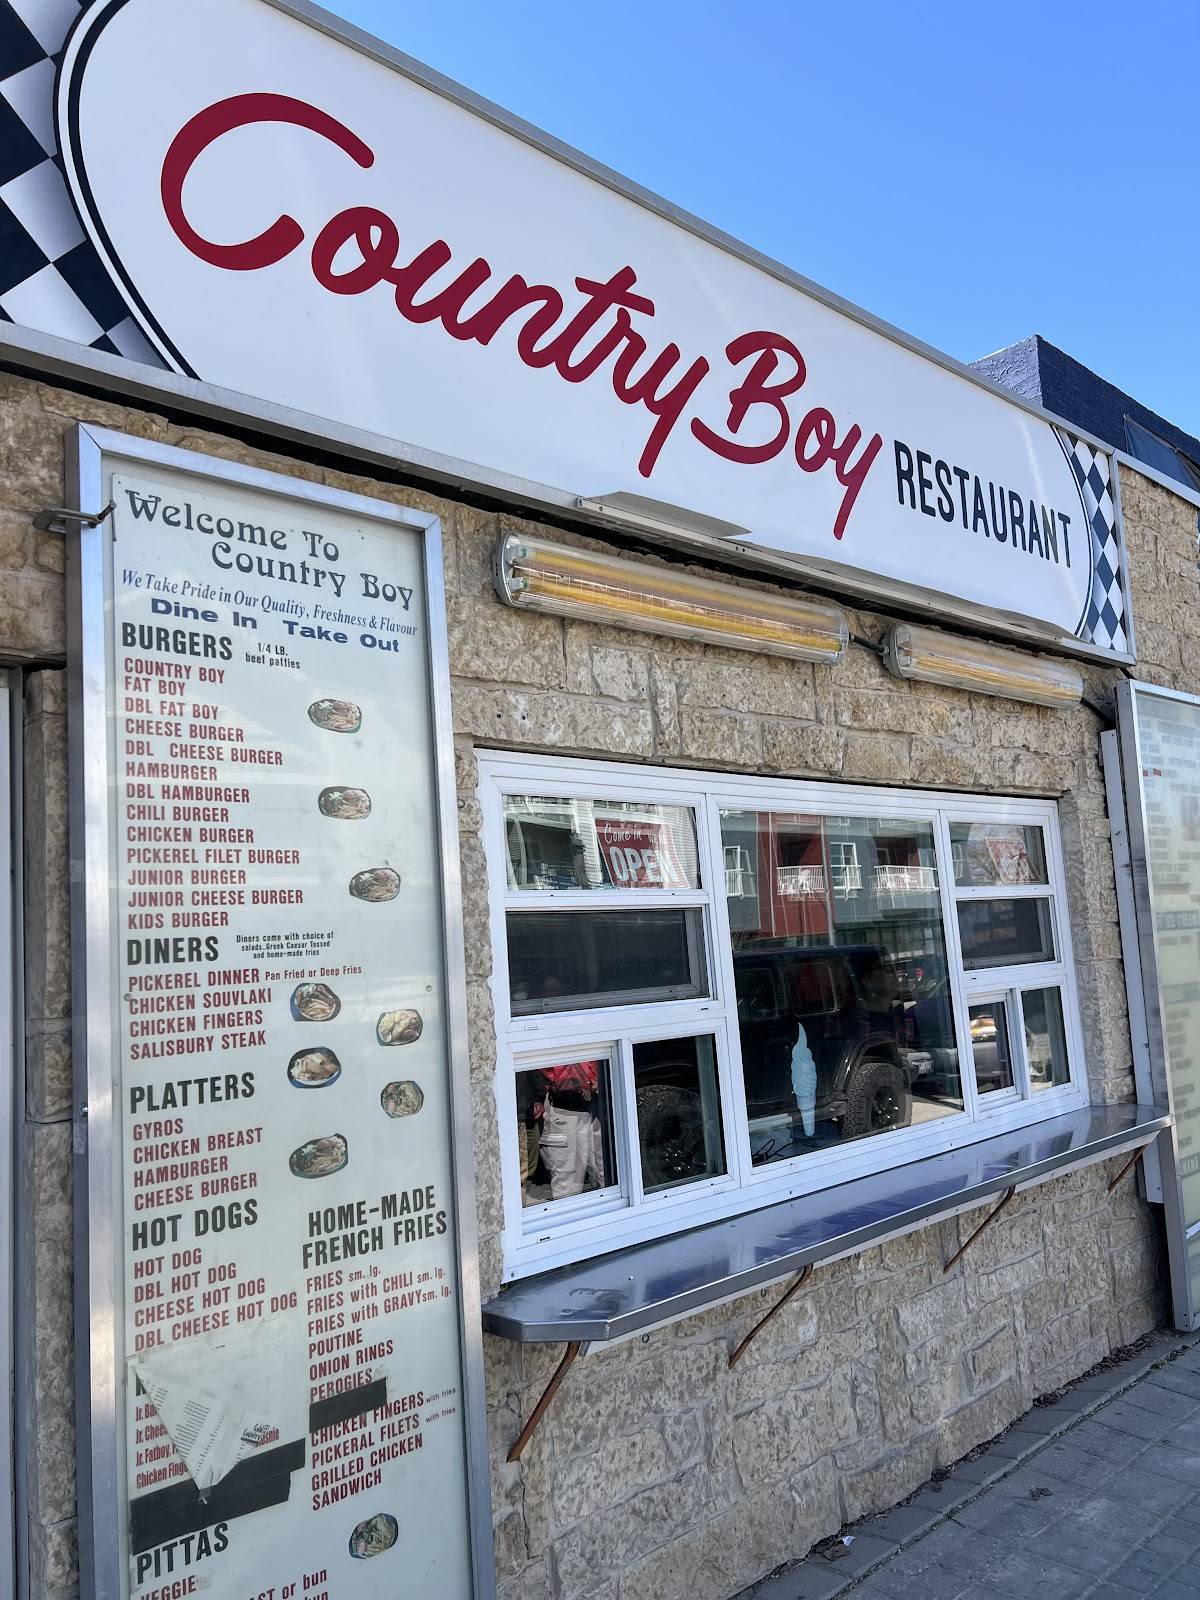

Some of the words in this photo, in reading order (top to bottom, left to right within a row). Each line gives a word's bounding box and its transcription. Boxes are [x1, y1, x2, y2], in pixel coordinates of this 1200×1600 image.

[160, 92, 709, 478] Country
[690, 330, 883, 540] Boy
[893, 439, 1071, 568] RESTAURANT
[125, 489, 288, 550] Welcome
[302, 530, 340, 562] To
[212, 541, 346, 598] Country
[360, 572, 414, 611] Boy
[122, 569, 143, 588] We
[145, 573, 179, 594] Take
[181, 580, 216, 601] Pride
[218, 588, 231, 603] in
[234, 590, 259, 608] Our
[261, 595, 310, 620] Quality,
[313, 604, 367, 629] Freshness
[368, 615, 378, 629] &
[380, 617, 418, 636] Flavour
[151, 597, 219, 623] Dine
[233, 611, 257, 630] In
[122, 622, 233, 661] BURGERS
[257, 642, 271, 655] 1/4
[275, 645, 288, 657] LB.
[282, 619, 349, 644] Take
[359, 633, 400, 653] Out
[124, 657, 192, 680] COUNTRY
[199, 667, 225, 684] BOY
[269, 655, 301, 669] patties
[124, 676, 152, 693] FAT
[158, 680, 186, 697] BOY
[125, 697, 153, 714] DBL
[159, 700, 185, 717] FAT
[192, 703, 219, 720] BOY
[125, 718, 183, 739] CHEESE
[189, 723, 245, 743] BURGER
[125, 739, 154, 757] DBL
[169, 742, 224, 762] CHEESE
[230, 747, 283, 766] BURGER
[126, 761, 218, 782] HAMBURGER
[126, 782, 155, 800] DBL
[161, 785, 250, 803] HAMBURGER
[126, 804, 166, 821] CHILI
[172, 806, 229, 823] BURGER
[126, 826, 193, 843] CHICKEN
[199, 828, 255, 844] BURGER
[604, 822, 632, 844] Come
[127, 848, 199, 864] PICKEREL
[204, 848, 242, 864] FILET
[248, 849, 300, 865] BURGER
[609, 846, 680, 883] OPEN
[128, 869, 184, 886] JUNIOR
[190, 869, 247, 885] BURGER
[128, 890, 184, 908] JUNIOR
[191, 890, 246, 906] CHEESE
[251, 888, 304, 905] BURGER
[128, 912, 165, 930] KIDS
[172, 911, 229, 929] BURGER
[236, 934, 260, 943] Diners
[284, 932, 300, 941] with
[302, 931, 325, 941] choice
[326, 930, 335, 940] of
[127, 935, 219, 966] DINERS
[253, 951, 265, 959] and
[266, 949, 303, 959] home-made
[305, 948, 320, 957] fries
[286, 941, 308, 950] Caesar
[310, 940, 331, 948] Tossed
[129, 971, 201, 993] PICKEREL
[207, 968, 260, 988] DINNER
[265, 971, 281, 981] Pan
[284, 968, 305, 980] Fried
[308, 969, 317, 978] or
[320, 967, 340, 978] Deep
[342, 965, 362, 975] Fries
[128, 994, 196, 1016] CHICKEN
[203, 988, 272, 1009] SOUVLAKI
[129, 1016, 197, 1038] CHICKEN
[203, 1009, 263, 1031] FINGERS
[130, 1036, 214, 1061] SALISBURY
[221, 1030, 267, 1051] STEAK
[130, 1071, 256, 1114] PLATTERS
[133, 1118, 184, 1142] GYROS
[133, 1138, 201, 1165] CHICKEN
[207, 1126, 264, 1152] BREAST
[133, 1155, 229, 1188] HAMBURGER
[134, 1183, 194, 1211] CHEESE
[200, 1172, 258, 1198] BURGER
[132, 1214, 182, 1252] HOT
[194, 1198, 258, 1238] DOGS
[308, 1184, 436, 1239] HOME-MADE
[302, 1225, 384, 1270] FRENCH
[393, 1210, 448, 1246] FRIES
[133, 1255, 165, 1280] HOT
[172, 1247, 202, 1272] DOG
[306, 1270, 344, 1295] FRIES
[348, 1270, 366, 1283] sm.
[369, 1263, 381, 1279] lg.
[134, 1281, 165, 1304] DBL
[171, 1272, 200, 1295] HOT
[207, 1262, 237, 1285] DOG
[306, 1291, 344, 1317] FRIES
[350, 1280, 378, 1302] with
[382, 1271, 413, 1293] CHILI
[416, 1271, 433, 1284] sm.
[435, 1265, 447, 1280] lg.
[134, 1296, 195, 1328] CHEESE
[202, 1286, 231, 1309] HOT
[237, 1277, 266, 1300] DOG
[307, 1313, 345, 1338] FRIES
[351, 1303, 379, 1325] with
[383, 1288, 423, 1314] GRAVY
[422, 1289, 439, 1303] sm.
[440, 1284, 452, 1299] lg.
[134, 1329, 165, 1353] DBL
[171, 1309, 230, 1342] CHEESE
[236, 1299, 265, 1323] HOT
[270, 1291, 298, 1313] DOG
[308, 1327, 364, 1360] POUTINE
[309, 1355, 350, 1381] ONION
[355, 1339, 394, 1363] RINGS
[310, 1367, 373, 1404] PEROGIES
[311, 1412, 368, 1447] CHICKEN
[373, 1391, 425, 1424] FINGERS
[425, 1392, 440, 1404] with
[441, 1386, 457, 1398] fries
[311, 1431, 375, 1469] PICKERAL
[380, 1413, 420, 1443] FILETS
[425, 1412, 440, 1423] with
[441, 1407, 457, 1417] fries
[136, 1467, 168, 1489] Chicken
[312, 1456, 365, 1492] GRILLED
[370, 1432, 423, 1467] CHICKEN
[312, 1468, 382, 1512] SANDWICH
[137, 1522, 229, 1585] PITTAS
[281, 1582, 297, 1600] or
[302, 1569, 328, 1591] bun
